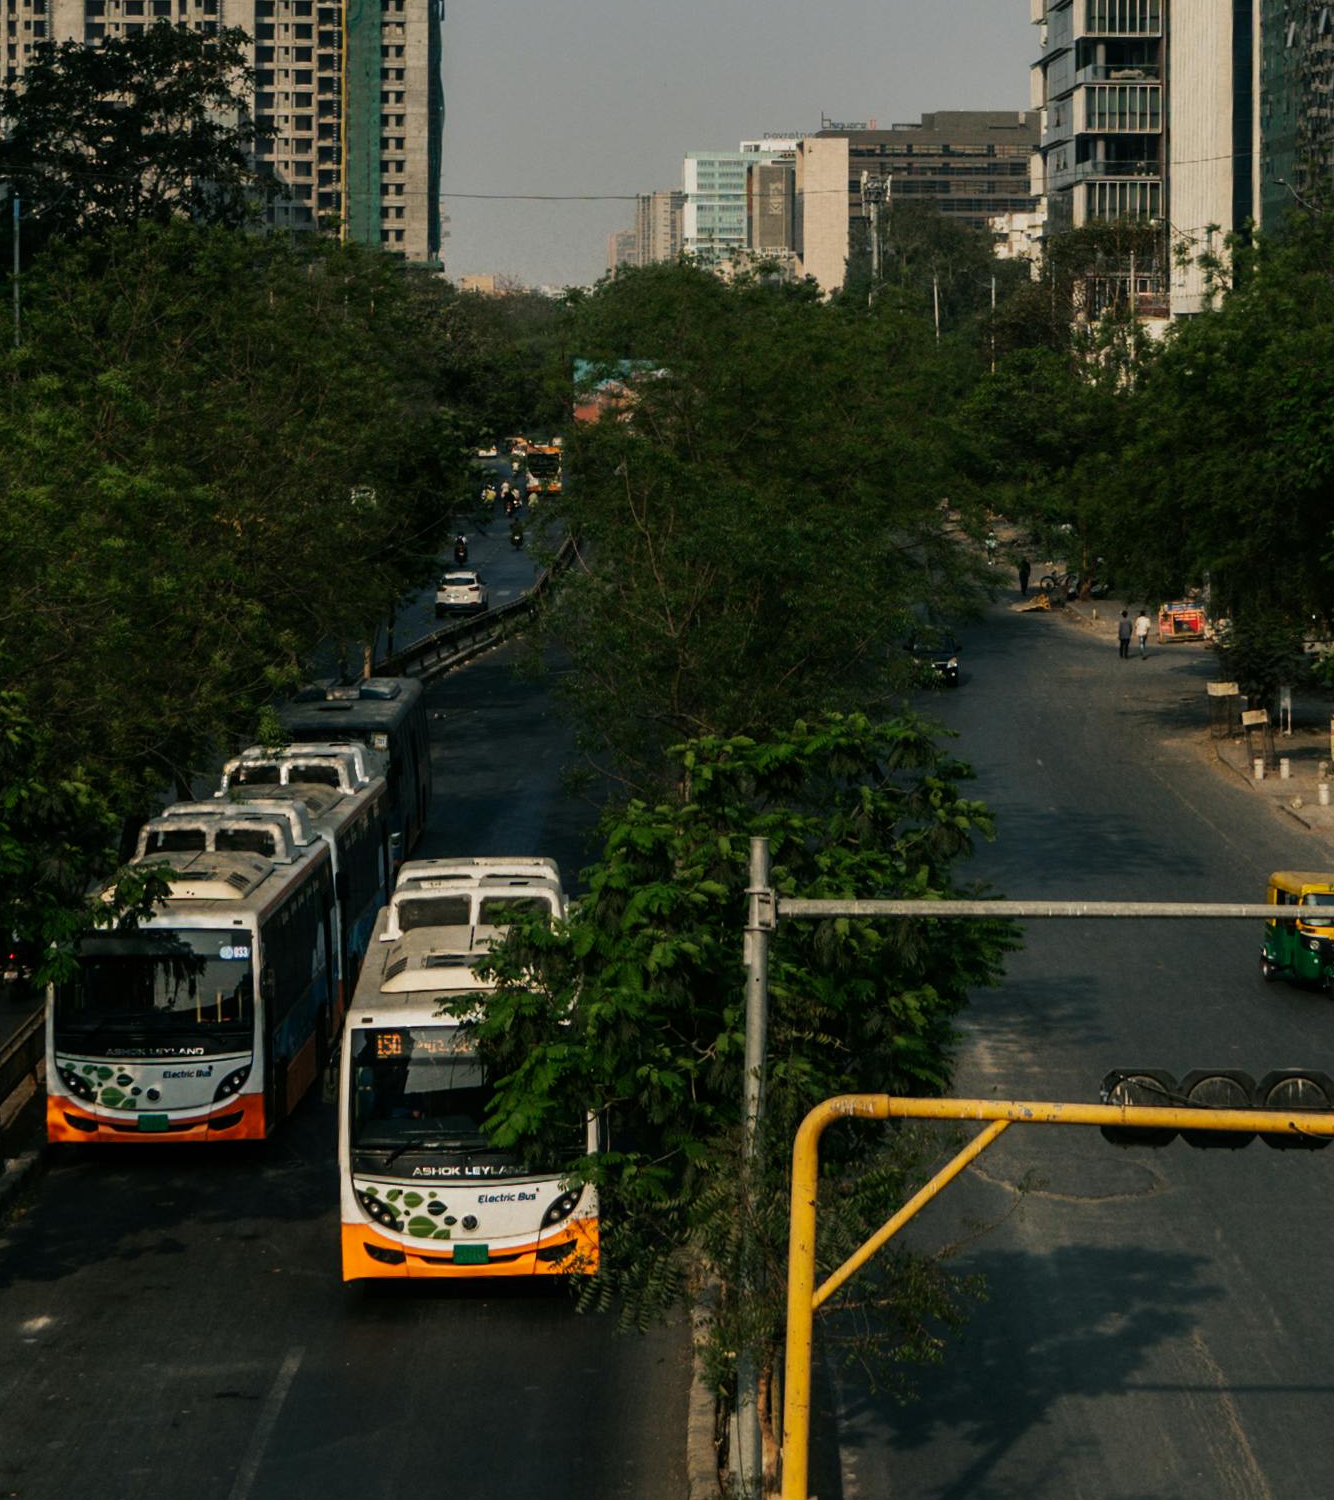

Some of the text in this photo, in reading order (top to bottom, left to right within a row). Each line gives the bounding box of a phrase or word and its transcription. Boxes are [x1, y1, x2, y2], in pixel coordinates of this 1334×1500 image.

[106, 1047, 205, 1057] ASHOK LEYLAND
[163, 1069, 212, 1079] Electric Bus
[411, 1165, 530, 1176] ASHOK LEYLAND
[478, 1191, 536, 1204] Electric Bus
